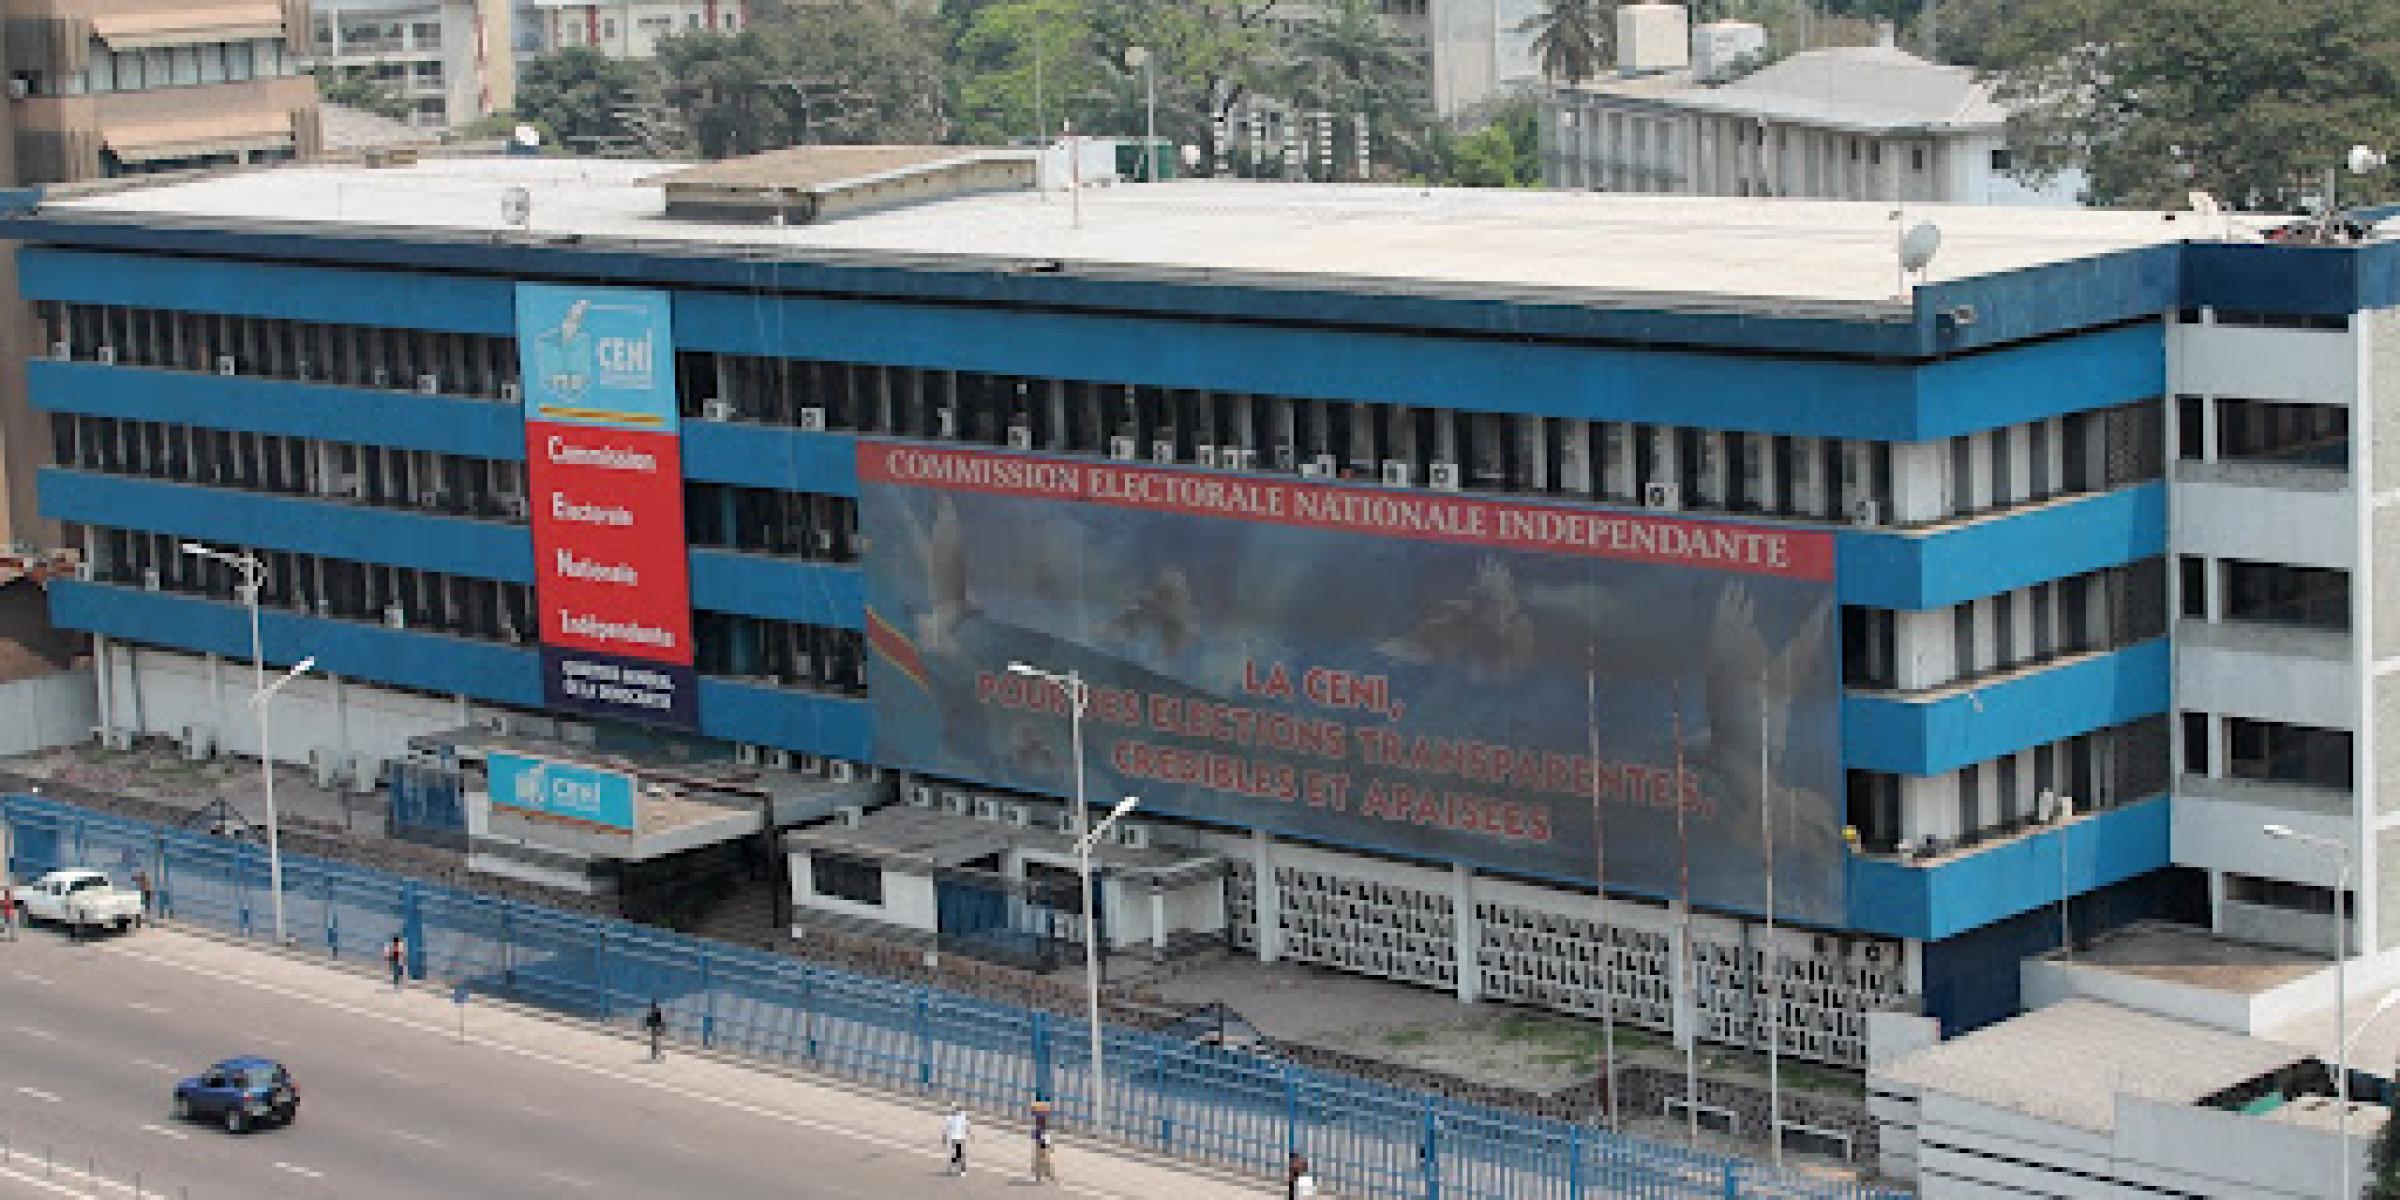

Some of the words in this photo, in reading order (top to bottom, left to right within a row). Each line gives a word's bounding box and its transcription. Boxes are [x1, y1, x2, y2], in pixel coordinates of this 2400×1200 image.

[885, 448, 1079, 493] COMMISSION
[1087, 466, 1286, 517] ELECTORALE
[1293, 489, 1487, 537] NATIONALE
[1497, 507, 1791, 569] INDEPENDANTE
[975, 670, 1072, 718] POUR
[1147, 692, 1348, 760] ELECTIONS
[1242, 660, 1294, 698] LA
[1303, 666, 1406, 722] CENI,
[1110, 740, 1298, 802] CREDIBLES
[1306, 769, 1351, 812] ET
[1359, 777, 1553, 840] APAISEES
